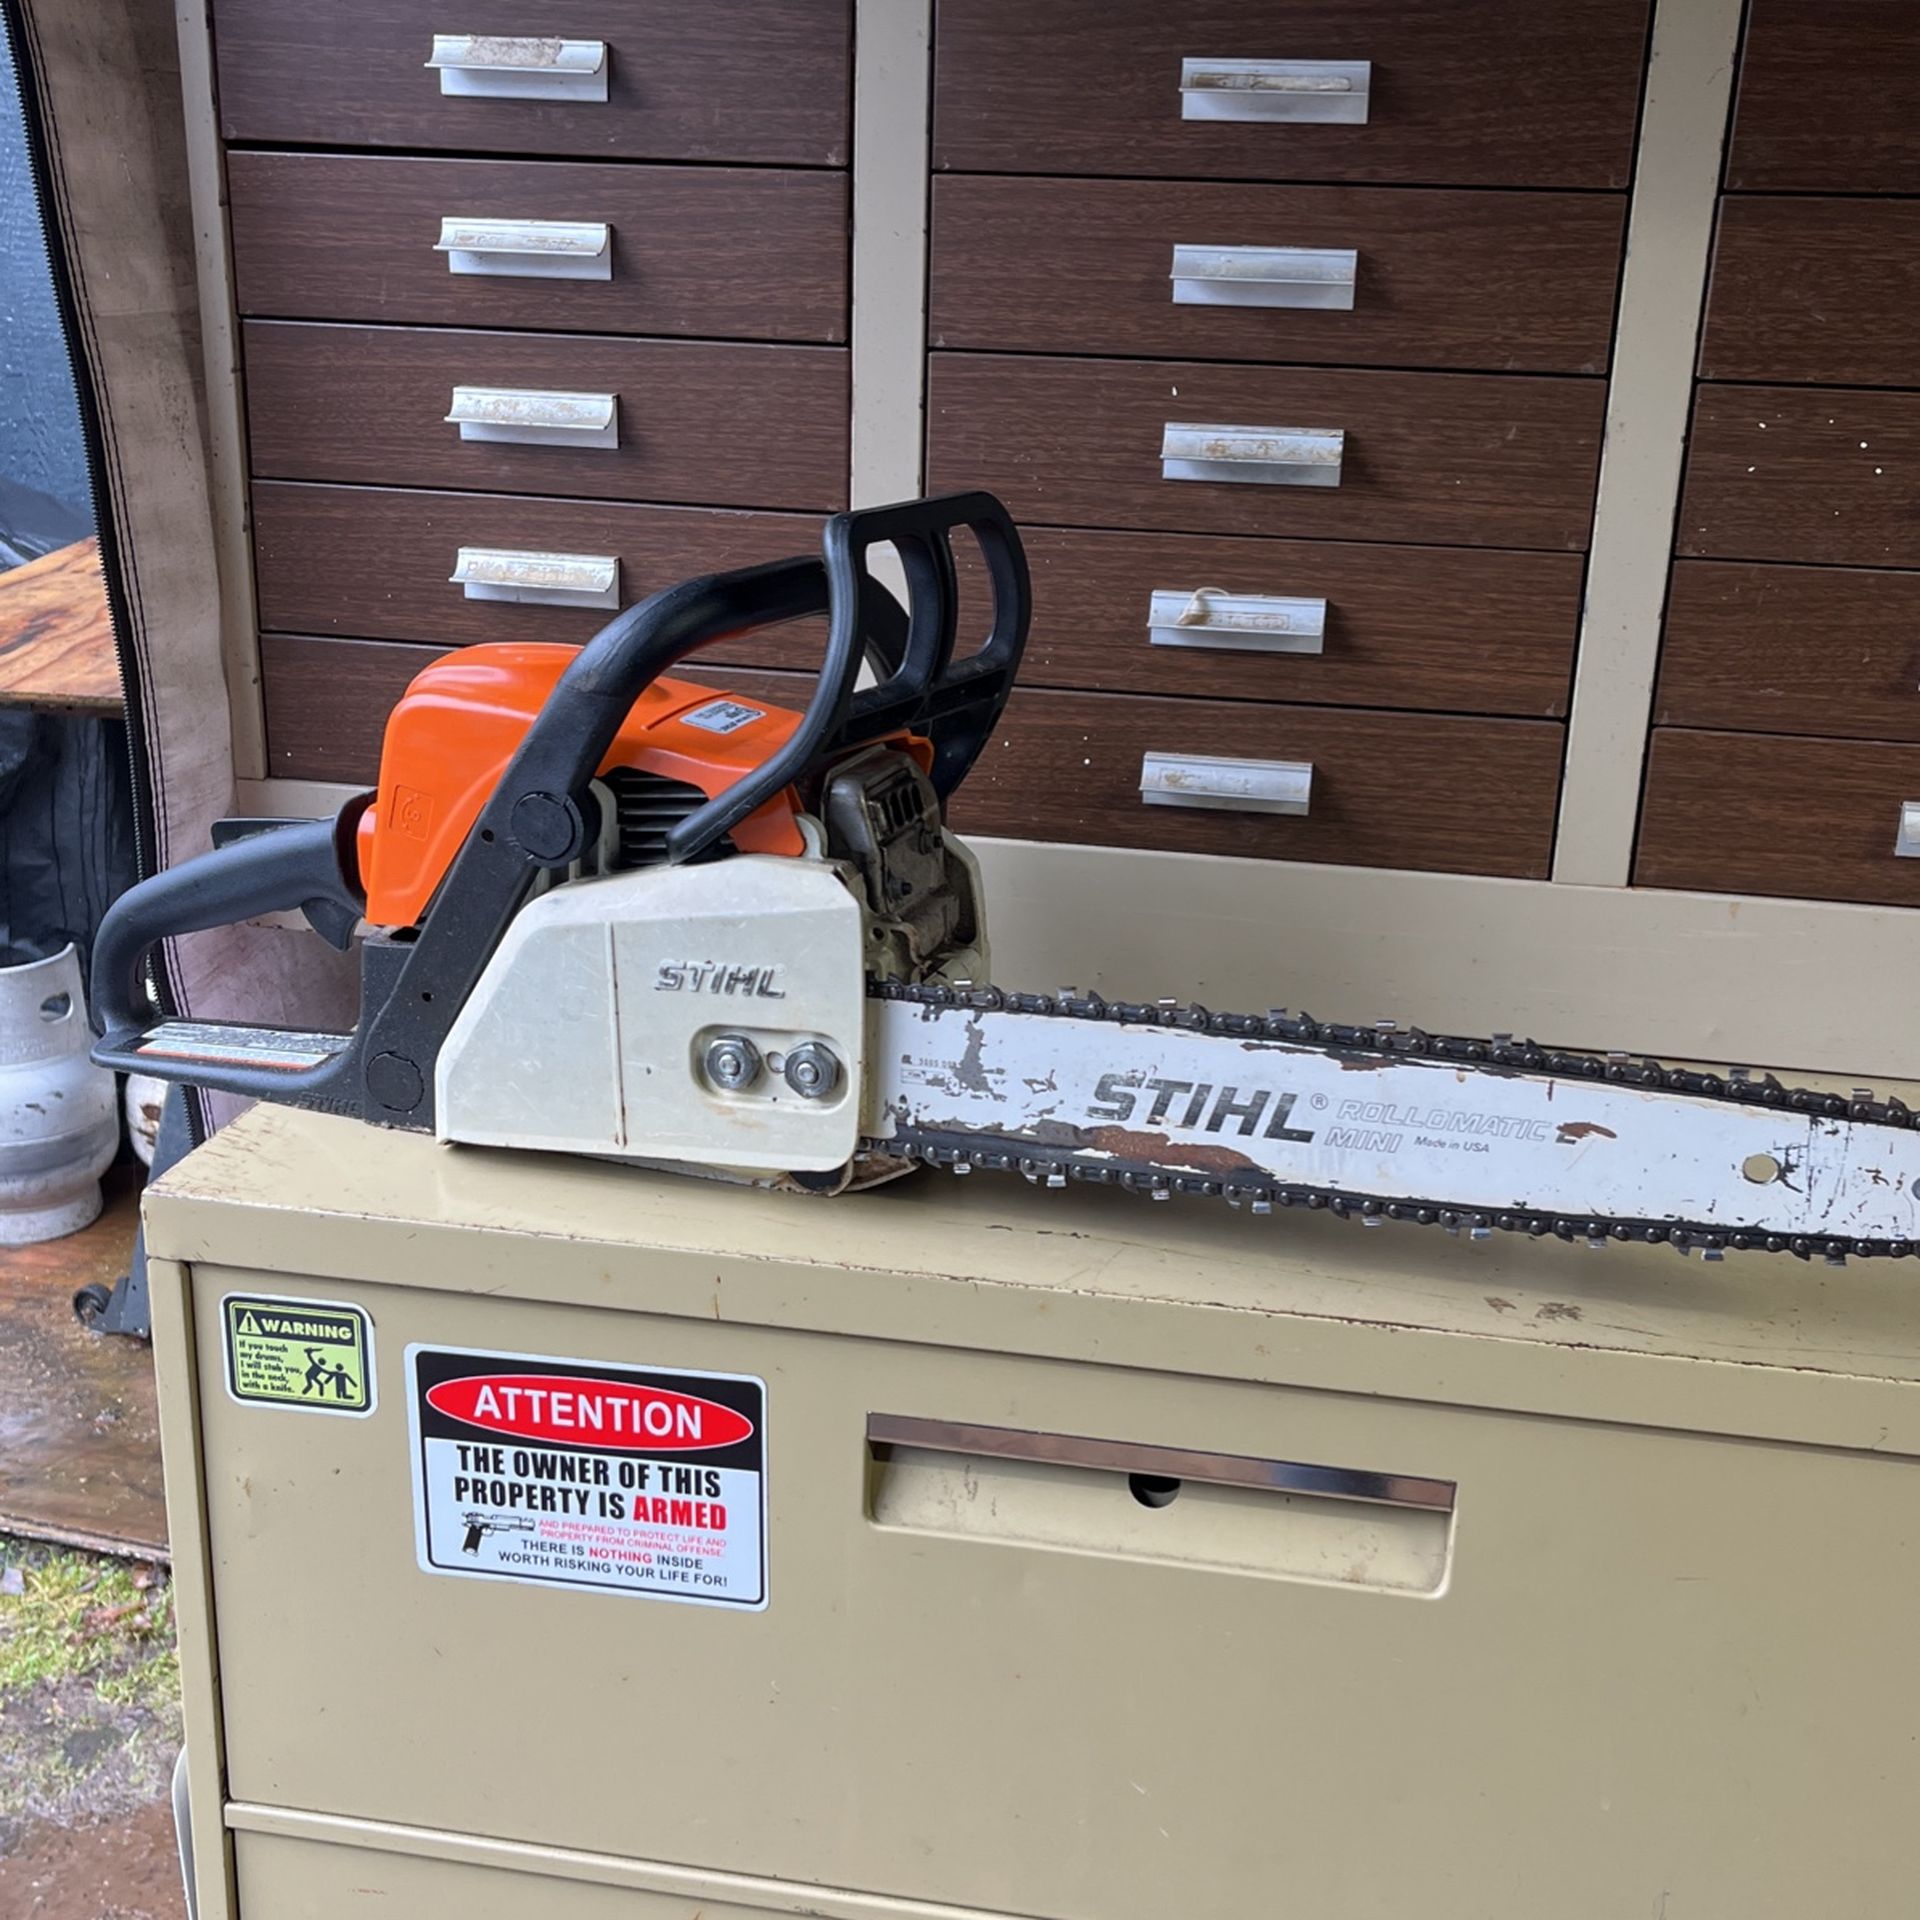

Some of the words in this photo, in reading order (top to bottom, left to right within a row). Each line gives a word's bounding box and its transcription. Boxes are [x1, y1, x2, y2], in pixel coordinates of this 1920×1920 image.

[654, 960, 786, 999] STIHL
[1087, 1073, 1314, 1143] STIHL
[1336, 1099, 1552, 1142] ROLLOMATIC
[1325, 1127, 1403, 1153] MINI
[1414, 1135, 1447, 1149] Made
[1463, 1141, 1490, 1153] USA
[261, 1318, 352, 1340] WARNING
[240, 1352, 252, 1360] my
[248, 1343, 263, 1351] you
[265, 1344, 289, 1353] touch
[247, 1361, 261, 1370] will
[264, 1363, 282, 1372] stab
[252, 1371, 265, 1380] the
[242, 1380, 260, 1389] with
[474, 1385, 702, 1440] ATTENTION
[456, 1445, 505, 1475] THE
[513, 1450, 610, 1486] OWNER
[619, 1461, 650, 1489] OF
[658, 1466, 721, 1498] THIS
[454, 1476, 590, 1515] PROPERTY
[599, 1491, 625, 1520] IS
[633, 1496, 727, 1531] ARMED
[539, 1519, 560, 1529] AND
[562, 1522, 615, 1535] PREPARED
[617, 1527, 631, 1537] TO
[633, 1528, 680, 1542] PROTECT
[682, 1535, 703, 1545] LIFE
[705, 1538, 727, 1548] AND
[540, 1529, 593, 1543] PROPERTY
[595, 1535, 625, 1546] FROM
[627, 1539, 673, 1552] CRIMINAL
[521, 1539, 567, 1556] THERE
[572, 1544, 585, 1556] IS
[589, 1547, 653, 1564] NOTHING
[657, 1554, 703, 1570] INSIDE
[498, 1551, 550, 1567] WORTH
[554, 1558, 612, 1574] RISKING
[615, 1565, 655, 1579] YOUR
[660, 1569, 689, 1583] LIFE
[694, 1574, 728, 1587] FOR!
